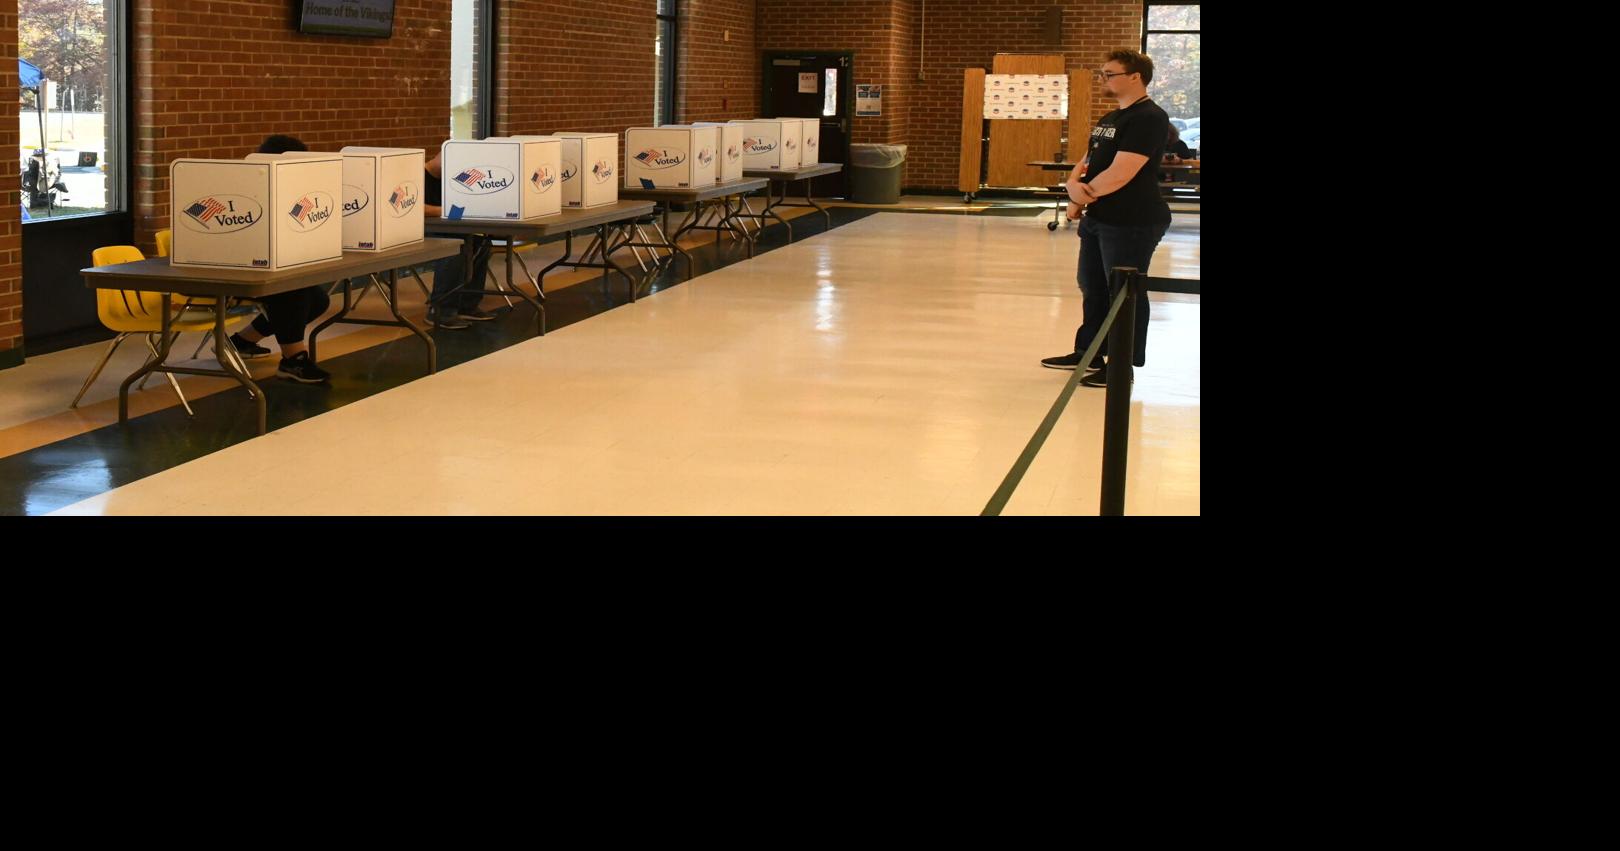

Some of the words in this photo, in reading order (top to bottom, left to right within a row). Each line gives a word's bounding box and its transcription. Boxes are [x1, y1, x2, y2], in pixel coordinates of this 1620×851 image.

[305, 2, 332, 16] Home
[334, 5, 344, 17] of
[344, 6, 359, 18] the
[751, 143, 772, 152] Voted
[654, 156, 680, 166] Voted
[487, 170, 493, 179] I
[477, 178, 507, 190] Voted
[228, 200, 234, 212] I
[400, 194, 416, 209] Voted
[215, 211, 254, 227] Voted
[307, 206, 329, 224] Voted
